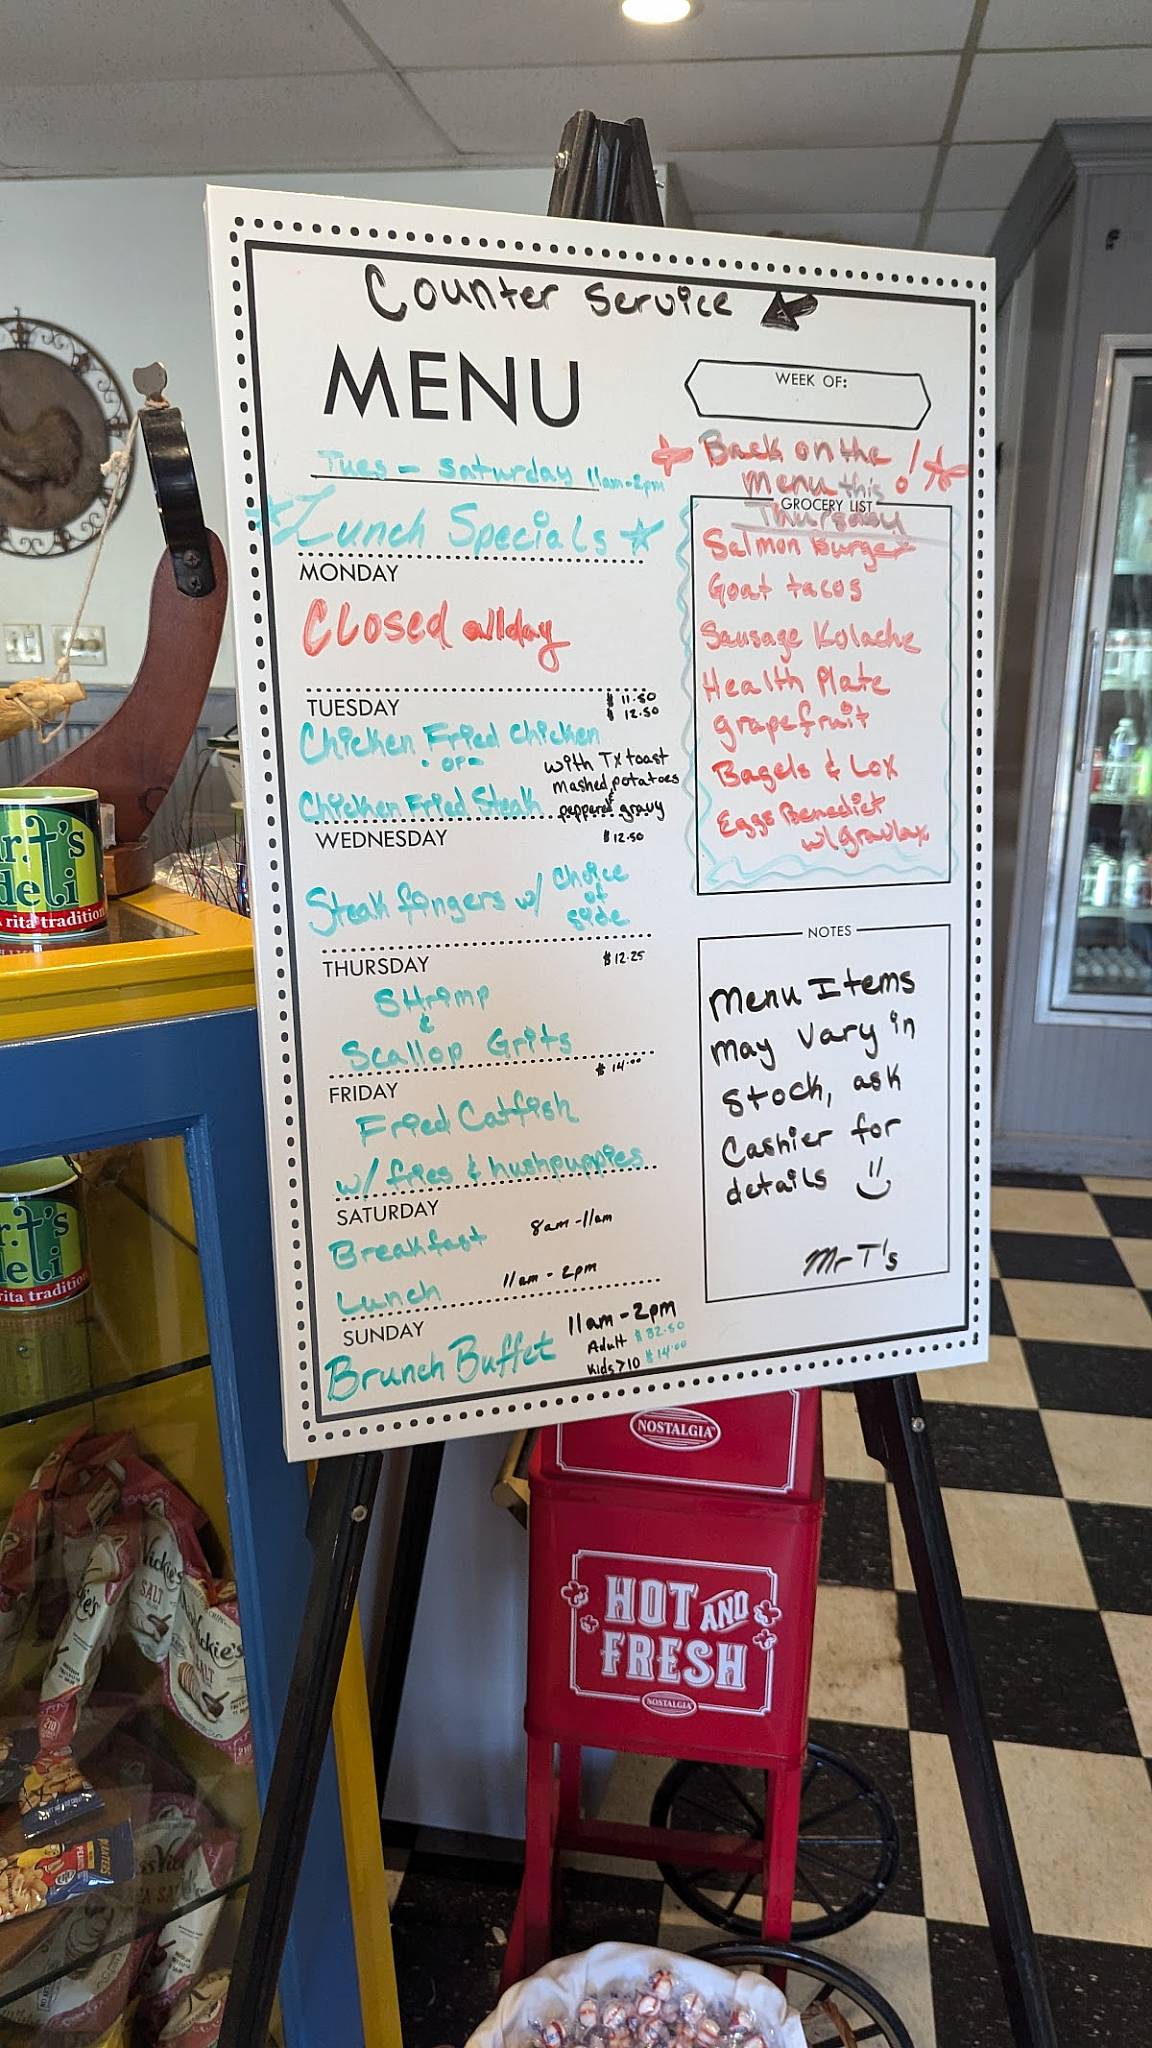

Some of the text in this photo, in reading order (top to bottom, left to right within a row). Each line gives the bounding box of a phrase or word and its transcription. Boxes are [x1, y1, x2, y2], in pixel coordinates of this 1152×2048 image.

[365, 264, 558, 321] Counter
[324, 344, 580, 428] MENU
[776, 372, 848, 388] WEEK OF:
[698, 429, 892, 468] Back on the
[318, 449, 389, 481] Tues
[278, 485, 427, 548] Lunch
[780, 497, 873, 513] GROCERY LIST
[703, 527, 801, 559] Salmon
[299, 564, 400, 582] MONDAY
[707, 572, 863, 609] Goat tacos
[700, 618, 923, 663] Sausage Kolache
[702, 661, 890, 703] Health Plate
[307, 698, 400, 717] TUESDAY
[300, 722, 416, 765] Chicken
[422, 722, 501, 751] Fried
[544, 751, 594, 774] with
[626, 746, 669, 766] toast
[712, 752, 811, 794] Bagels
[611, 771, 680, 793] potatoes
[299, 783, 542, 823] Chicken Fried Steak
[619, 800, 666, 824] gravy
[716, 791, 887, 839] Eggs Benedict
[315, 829, 448, 850] WEDNESDAY
[6, 915, 36, 930] rita
[305, 886, 391, 937] Steak
[397, 881, 506, 926] fingers
[567, 905, 630, 932] side
[808, 925, 852, 939] NOTES
[322, 956, 430, 977] THURSDAY
[808, 967, 917, 1000] Items
[889, 1010, 916, 1040] in
[341, 1023, 574, 1073] Scallop Grits
[328, 1082, 399, 1104] FRIDAY
[853, 1063, 902, 1092] ask
[355, 1089, 580, 1147] Fried Catfish
[850, 1112, 902, 1146] for
[386, 1158, 453, 1189] fries
[726, 1166, 828, 1206] details
[336, 1199, 439, 1227] SATURDAY
[328, 1225, 488, 1270] Breakfast
[857, 1239, 899, 1272] T's
[336, 1280, 443, 1316] Lunch
[342, 1321, 425, 1347] SUNDAY
[587, 1337, 628, 1355] Adult
[324, 1330, 558, 1402] Brunch Buffet
[638, 1418, 714, 1440] NOSTALGIA
[605, 1574, 750, 1633] HOT AND
[600, 1629, 748, 1692] FRESH
[646, 1697, 694, 1711] NOSTALGIA
